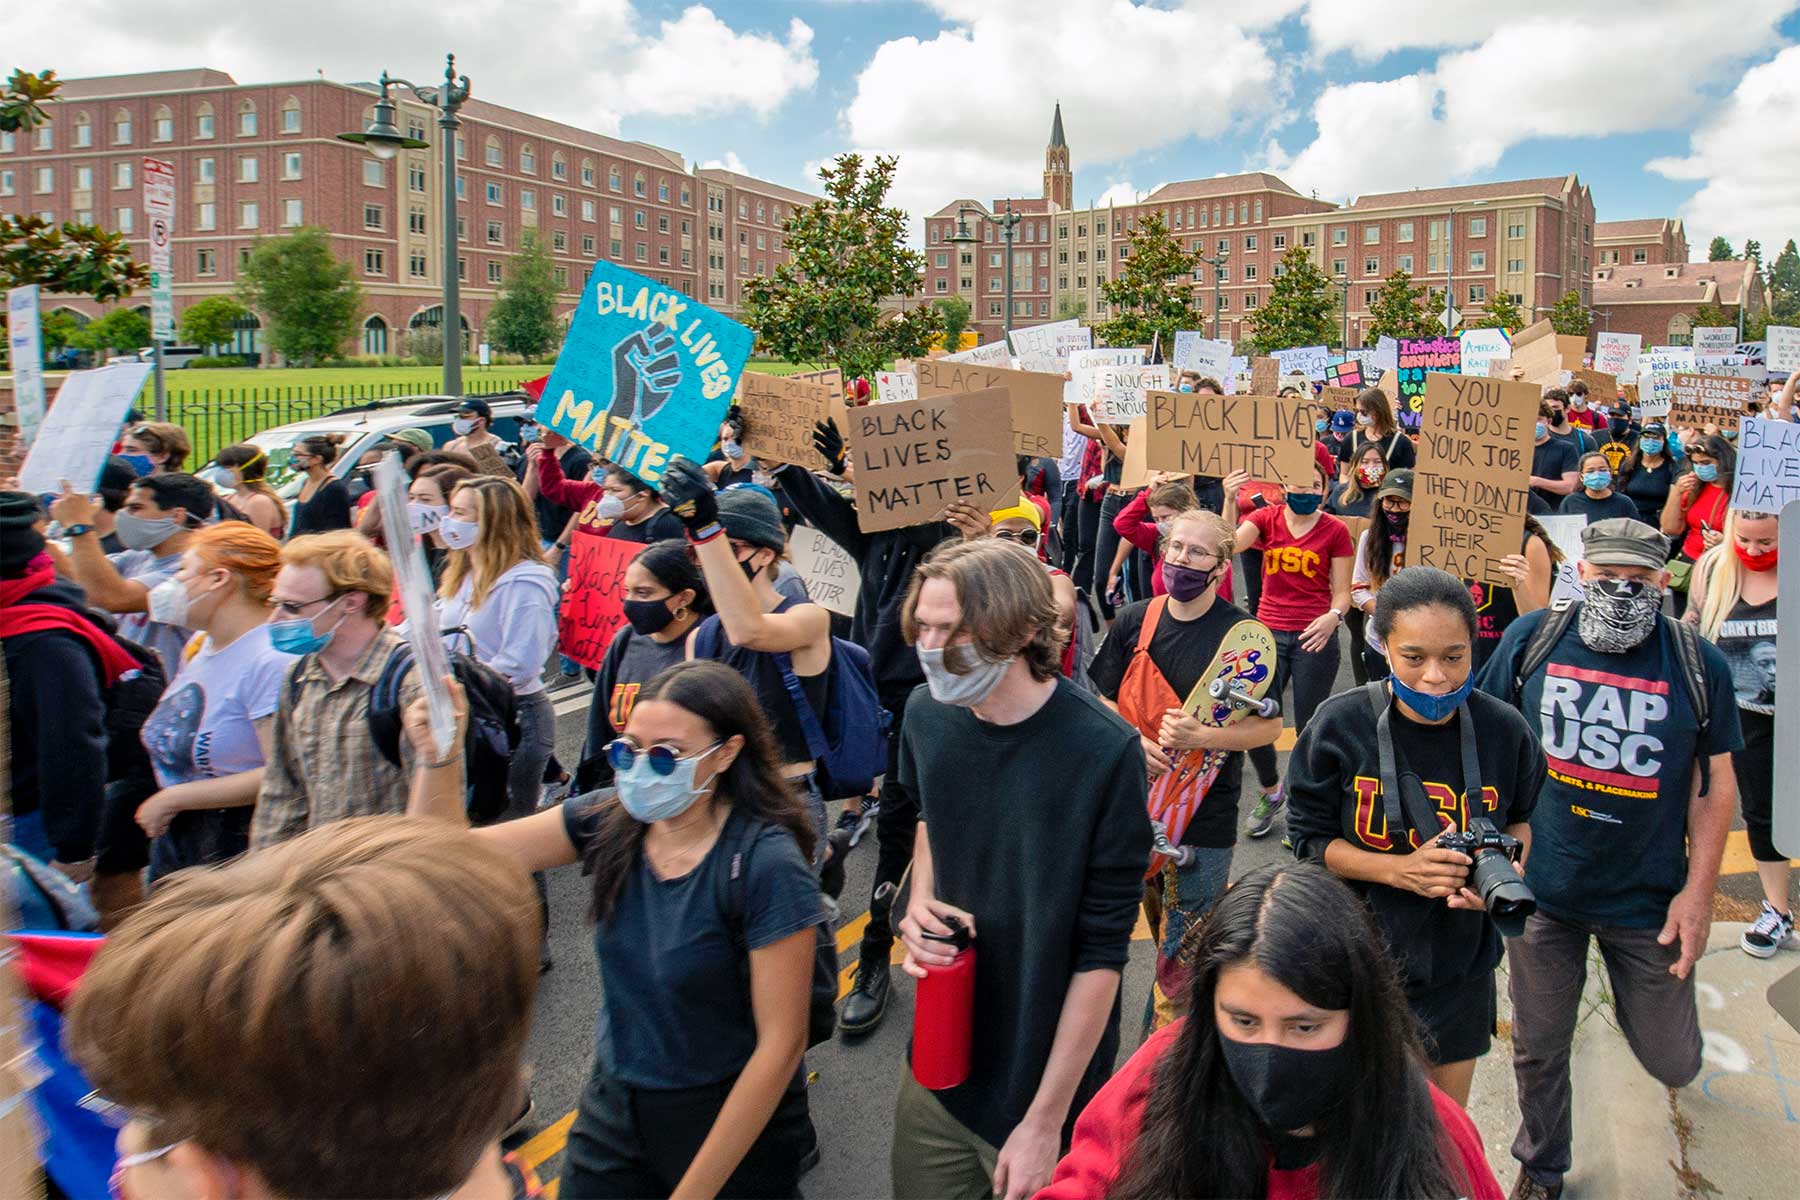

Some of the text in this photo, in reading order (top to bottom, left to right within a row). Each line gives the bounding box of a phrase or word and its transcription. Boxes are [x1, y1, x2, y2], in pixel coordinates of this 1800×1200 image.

[597, 282, 731, 399] BLACK LIVES
[1015, 329, 1056, 355] DEFU
[1400, 336, 1460, 355] Injustice
[1281, 352, 1312, 364] BLACK
[1399, 353, 1460, 368] anywhere
[1652, 361, 1688, 370] BODIES
[1105, 372, 1161, 389] ENOUGH
[1449, 378, 1500, 408] YOU
[1680, 376, 1739, 391] SILENCE
[1106, 401, 1147, 416] ENOU
[1641, 398, 1671, 406] MATT
[1672, 403, 1710, 414] BLACK
[861, 409, 947, 437] BLACK
[1154, 396, 1316, 448] BLACK LIVES
[1433, 406, 1520, 441] CHOOSE
[1676, 414, 1737, 427] MATTER
[551, 390, 686, 482] MATTE
[1008, 430, 1051, 454] TER
[1743, 420, 1800, 451] BLAC
[864, 439, 951, 471] LIVES
[1181, 440, 1289, 482] MATTER.
[1424, 431, 1523, 472] YOUR JOB.
[1739, 455, 1800, 479] LIVE
[868, 472, 997, 514] MATTER
[1419, 472, 1469, 502] THEY
[1735, 479, 1800, 507] MATT
[1433, 502, 1504, 534] CHOOSE
[1432, 525, 1488, 553] THEIR
[812, 556, 849, 578] LIVES
[1265, 547, 1320, 579] USC
[1420, 544, 1508, 586] RACE.
[1540, 675, 1668, 734] RAP
[1540, 714, 1664, 777] USC
[1560, 775, 1584, 788] ARTS,
[1586, 782, 1594, 790] &
[1595, 783, 1659, 799] PLACEMAKING
[1571, 805, 1590, 817] USC
